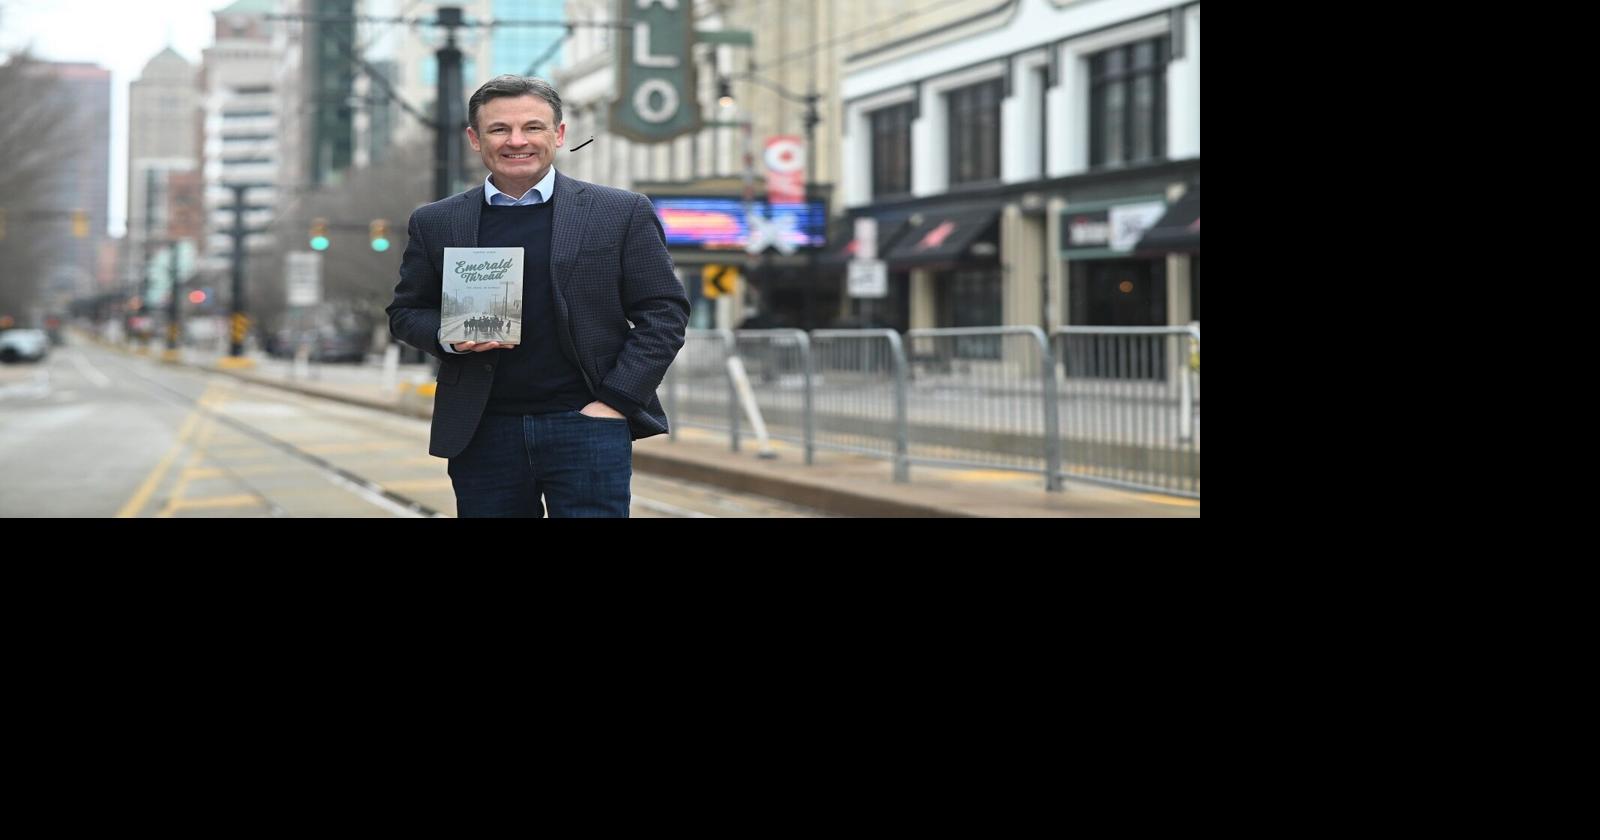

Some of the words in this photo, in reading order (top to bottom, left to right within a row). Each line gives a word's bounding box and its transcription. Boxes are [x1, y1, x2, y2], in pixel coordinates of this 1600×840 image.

[633, 0, 681, 123] LO
[455, 258, 513, 274] Emerald
[461, 269, 508, 283] Thread
